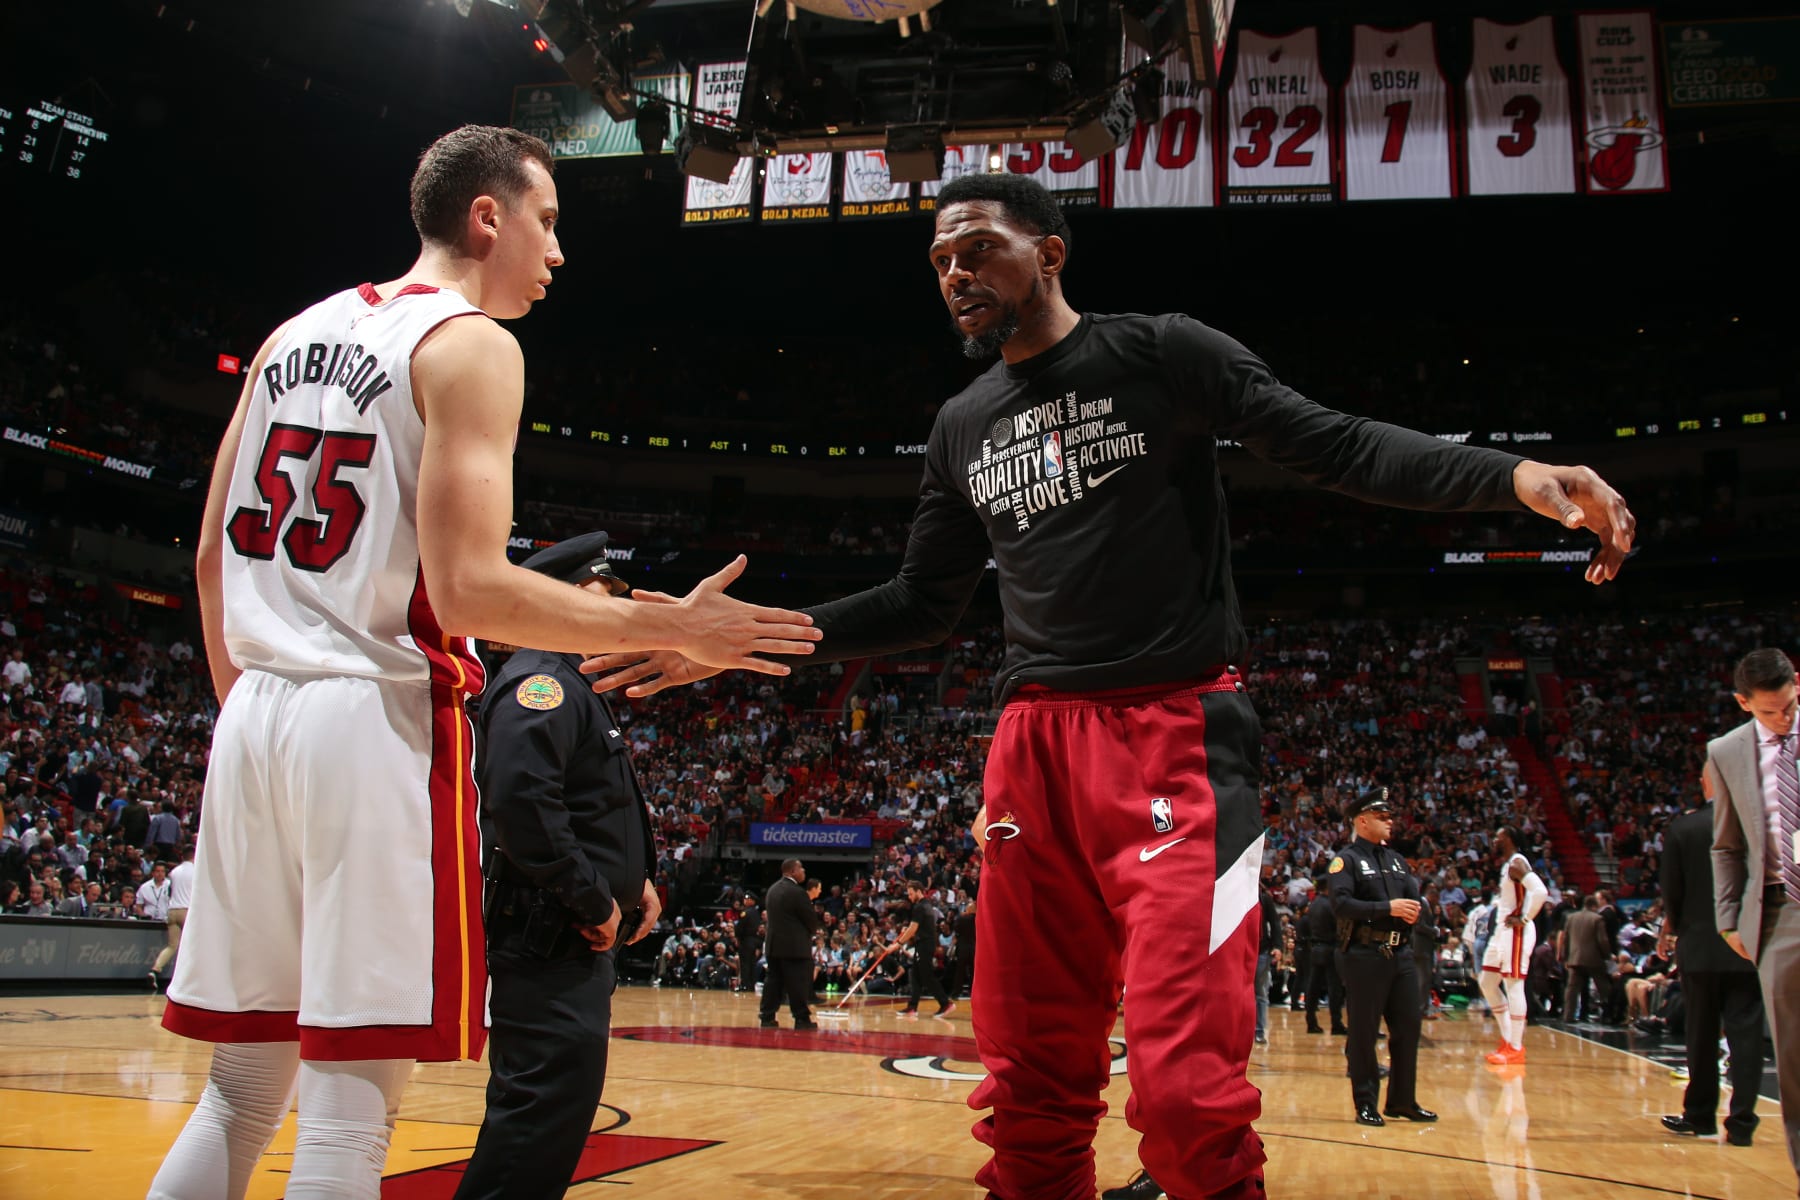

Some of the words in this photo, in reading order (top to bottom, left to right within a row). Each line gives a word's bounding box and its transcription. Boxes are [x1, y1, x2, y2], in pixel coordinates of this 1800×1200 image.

[704, 69, 745, 83] LEBRO
[1249, 75, 1308, 96] O'NEAL
[1370, 70, 1420, 91] BOSH
[1489, 64, 1543, 84] WADE
[1673, 67, 1718, 86] LEED
[706, 81, 744, 96] JAME
[41, 100, 65, 117] TEAM
[66, 109, 94, 127] STATS
[552, 125, 600, 140] GOLD
[1233, 105, 1323, 168] 32
[1381, 100, 1412, 163] 1
[1496, 94, 1542, 157] 3
[23, 134, 37, 147] 21
[71, 150, 86, 163] 37
[78, 134, 91, 147] 14
[1124, 107, 1202, 170] 10
[19, 150, 33, 164] 38
[841, 203, 869, 216] GOLD
[871, 200, 911, 215] MEDAL
[919, 198, 936, 210] GO
[1229, 194, 1254, 204] HALL
[1257, 194, 1270, 203] OF
[1271, 193, 1299, 204] FAME
[684, 209, 711, 223] GOLD
[712, 206, 750, 220] MEDAL
[761, 208, 789, 221] GOLD
[791, 206, 830, 220] MEDAL
[1066, 391, 1078, 423] ENGAGE
[1080, 397, 1112, 420] DREAM
[1014, 399, 1066, 440] INSPIRE
[1616, 427, 1636, 437] MIN
[1646, 424, 1659, 434] 10
[1679, 420, 1700, 431] PTS
[1712, 418, 1721, 428] 2
[1742, 413, 1767, 424] REB
[532, 422, 551, 433] MIN
[561, 426, 572, 437] 10
[590, 430, 610, 442] PTS
[621, 435, 629, 444] 2
[648, 437, 670, 447] REB
[682, 439, 687, 448] 1
[710, 441, 729, 450] AST
[742, 442, 747, 451] 1
[770, 444, 788, 454] STL
[800, 446, 807, 455] 0
[828, 447, 847, 456] BLK
[858, 446, 865, 455] 0
[1064, 419, 1104, 447] HISTORY
[1105, 421, 1127, 435] JUSTICE
[1513, 431, 1552, 443] Iguodala
[3, 426, 48, 450] BLACK
[49, 439, 105, 465] HISTORY
[103, 455, 155, 479] MONTH
[982, 438, 991, 468] UNIFY
[992, 436, 1040, 464] PERSEVERANCE
[1080, 432, 1147, 468] ACTIVATE
[968, 460, 981, 475] LEAD
[968, 449, 1042, 508] EQUALITY
[1065, 449, 1083, 501] EMPOWER
[226, 421, 378, 573] 55
[990, 496, 1011, 516] LISTEN
[1025, 476, 1069, 514] LOVE
[1011, 490, 1030, 533] BELIEVE
[507, 536, 533, 550] ACK
[1444, 552, 1485, 563] BLACK
[1487, 551, 1542, 562] HISTORY
[1541, 548, 1594, 562] MONTH
[762, 826, 858, 844] ticketmaster
[77, 941, 142, 965] Florida
